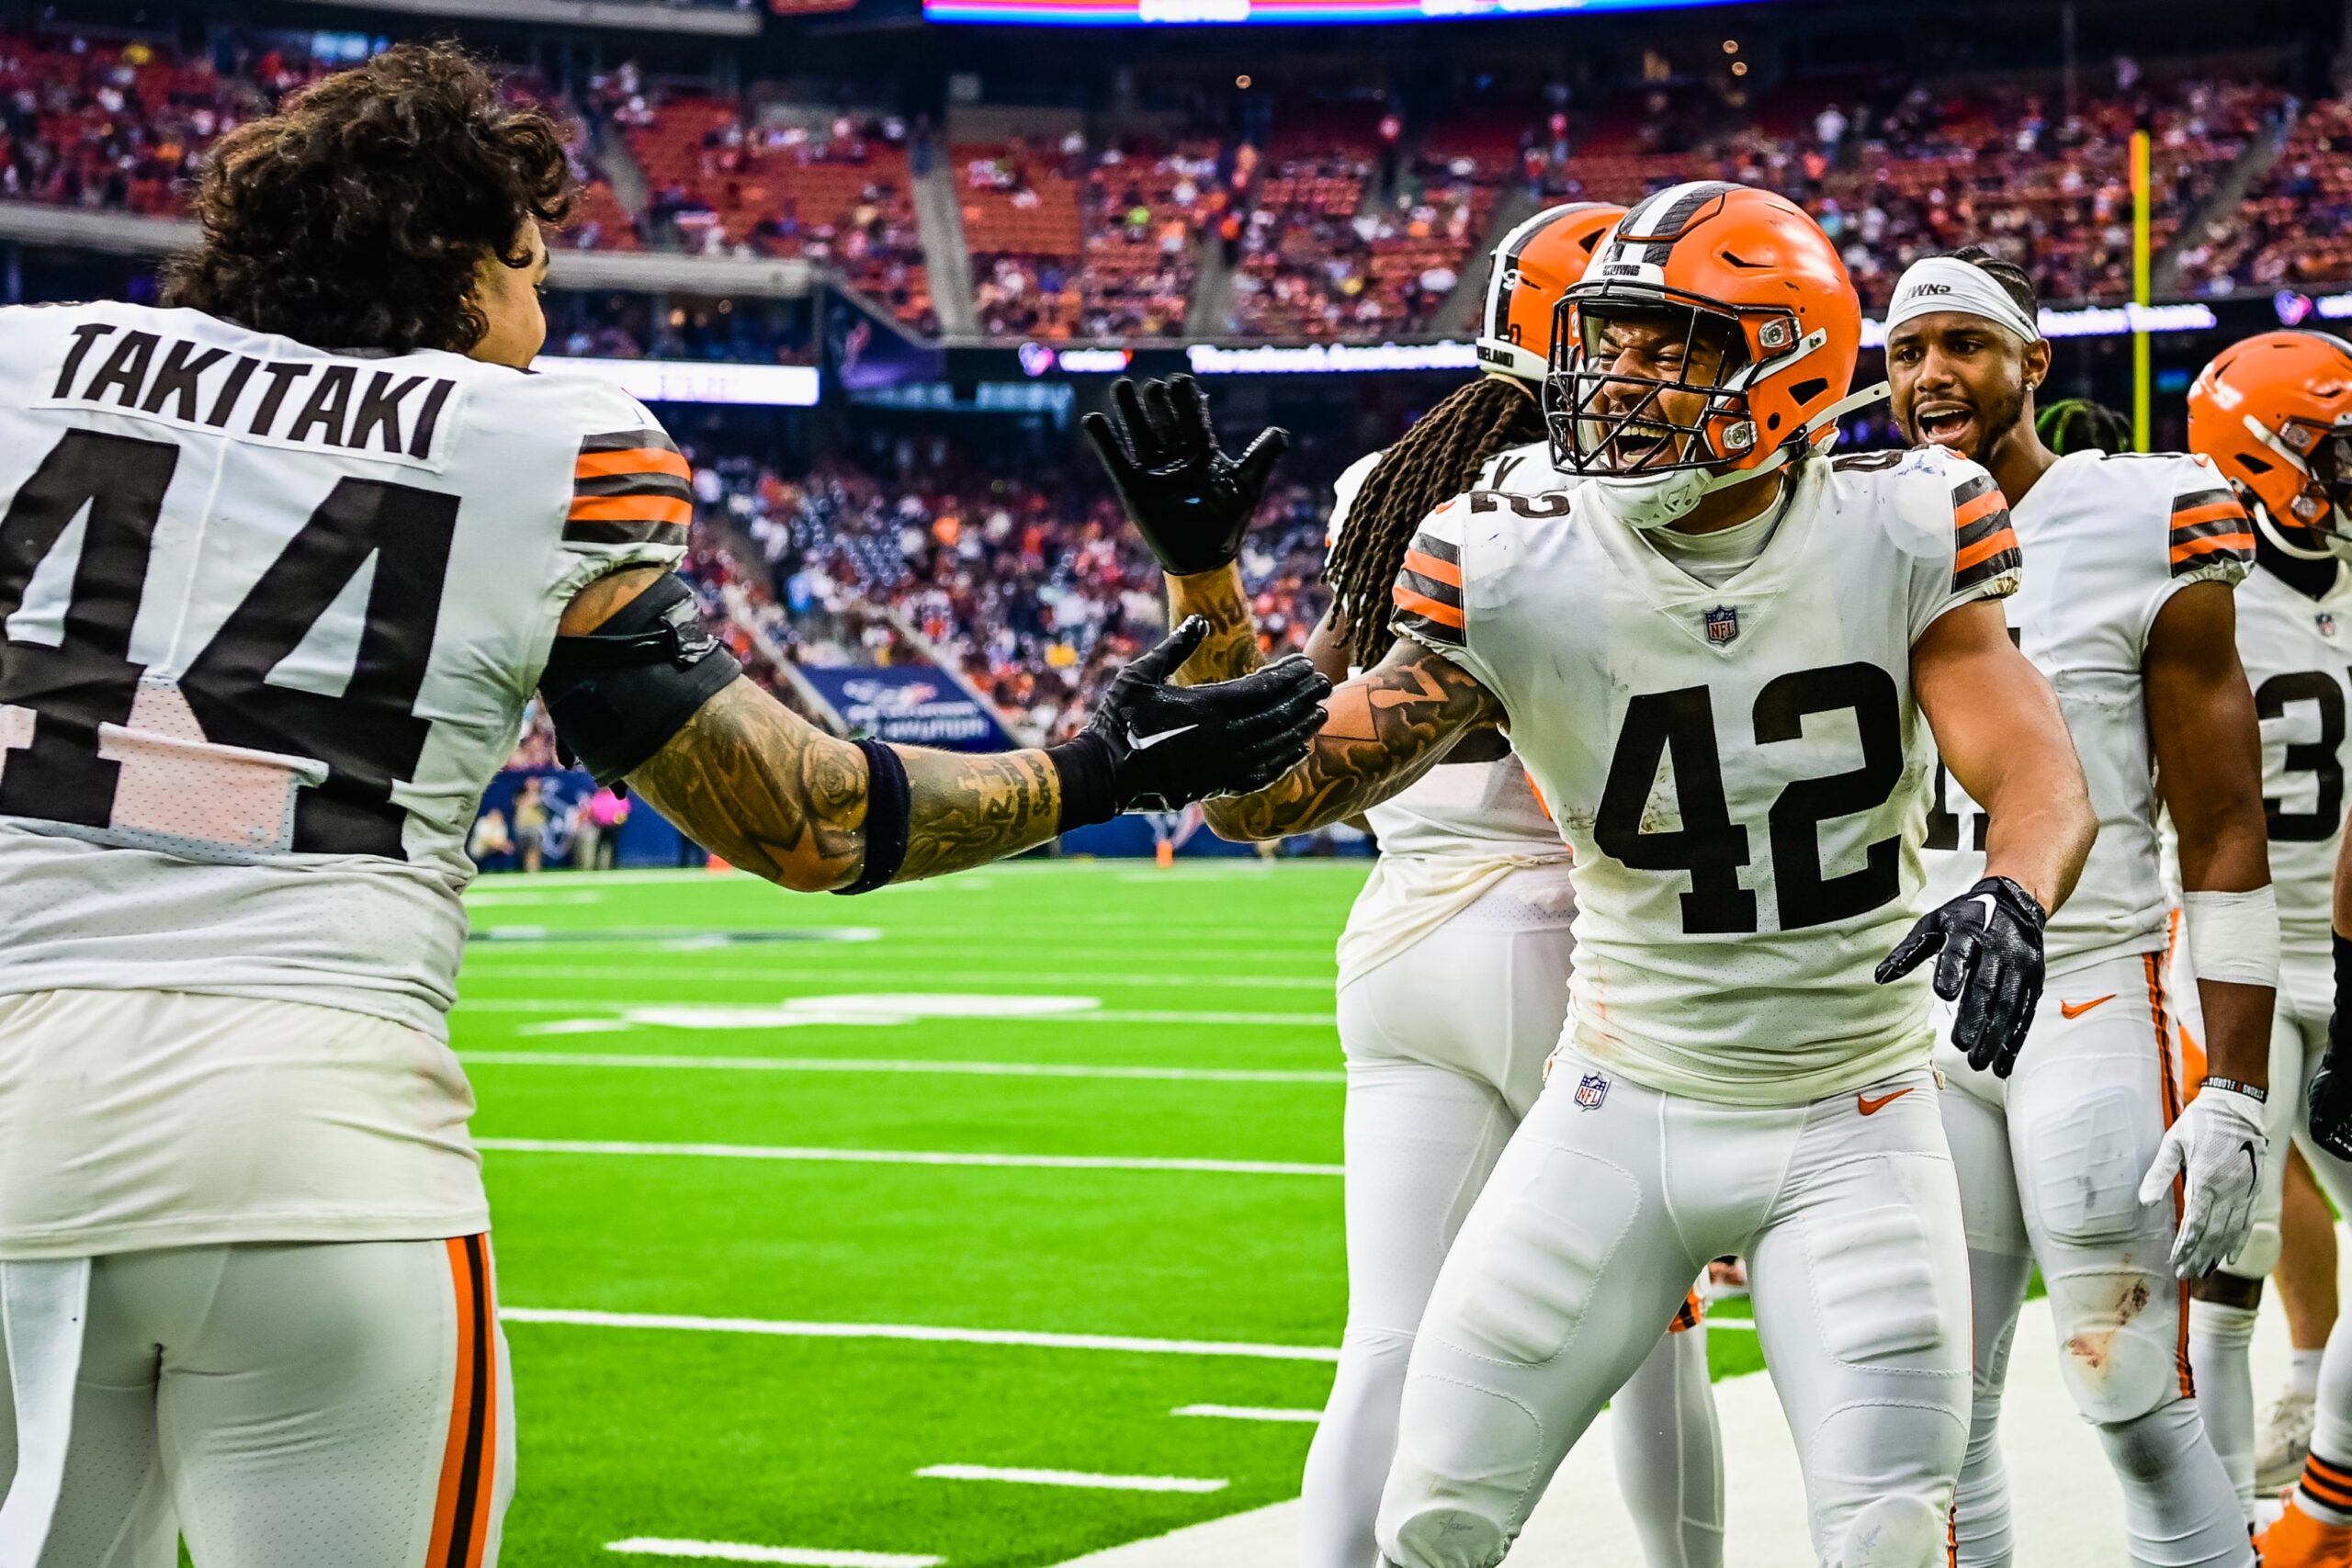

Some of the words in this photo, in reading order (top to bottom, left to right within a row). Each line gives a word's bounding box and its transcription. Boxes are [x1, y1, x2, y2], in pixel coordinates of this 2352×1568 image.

[52, 322, 458, 459] TAKITAKI
[0, 427, 461, 862] 44
[1710, 621, 1735, 639] NFL
[1593, 660, 1905, 934] 42
[1577, 1087, 1600, 1104] NFL
